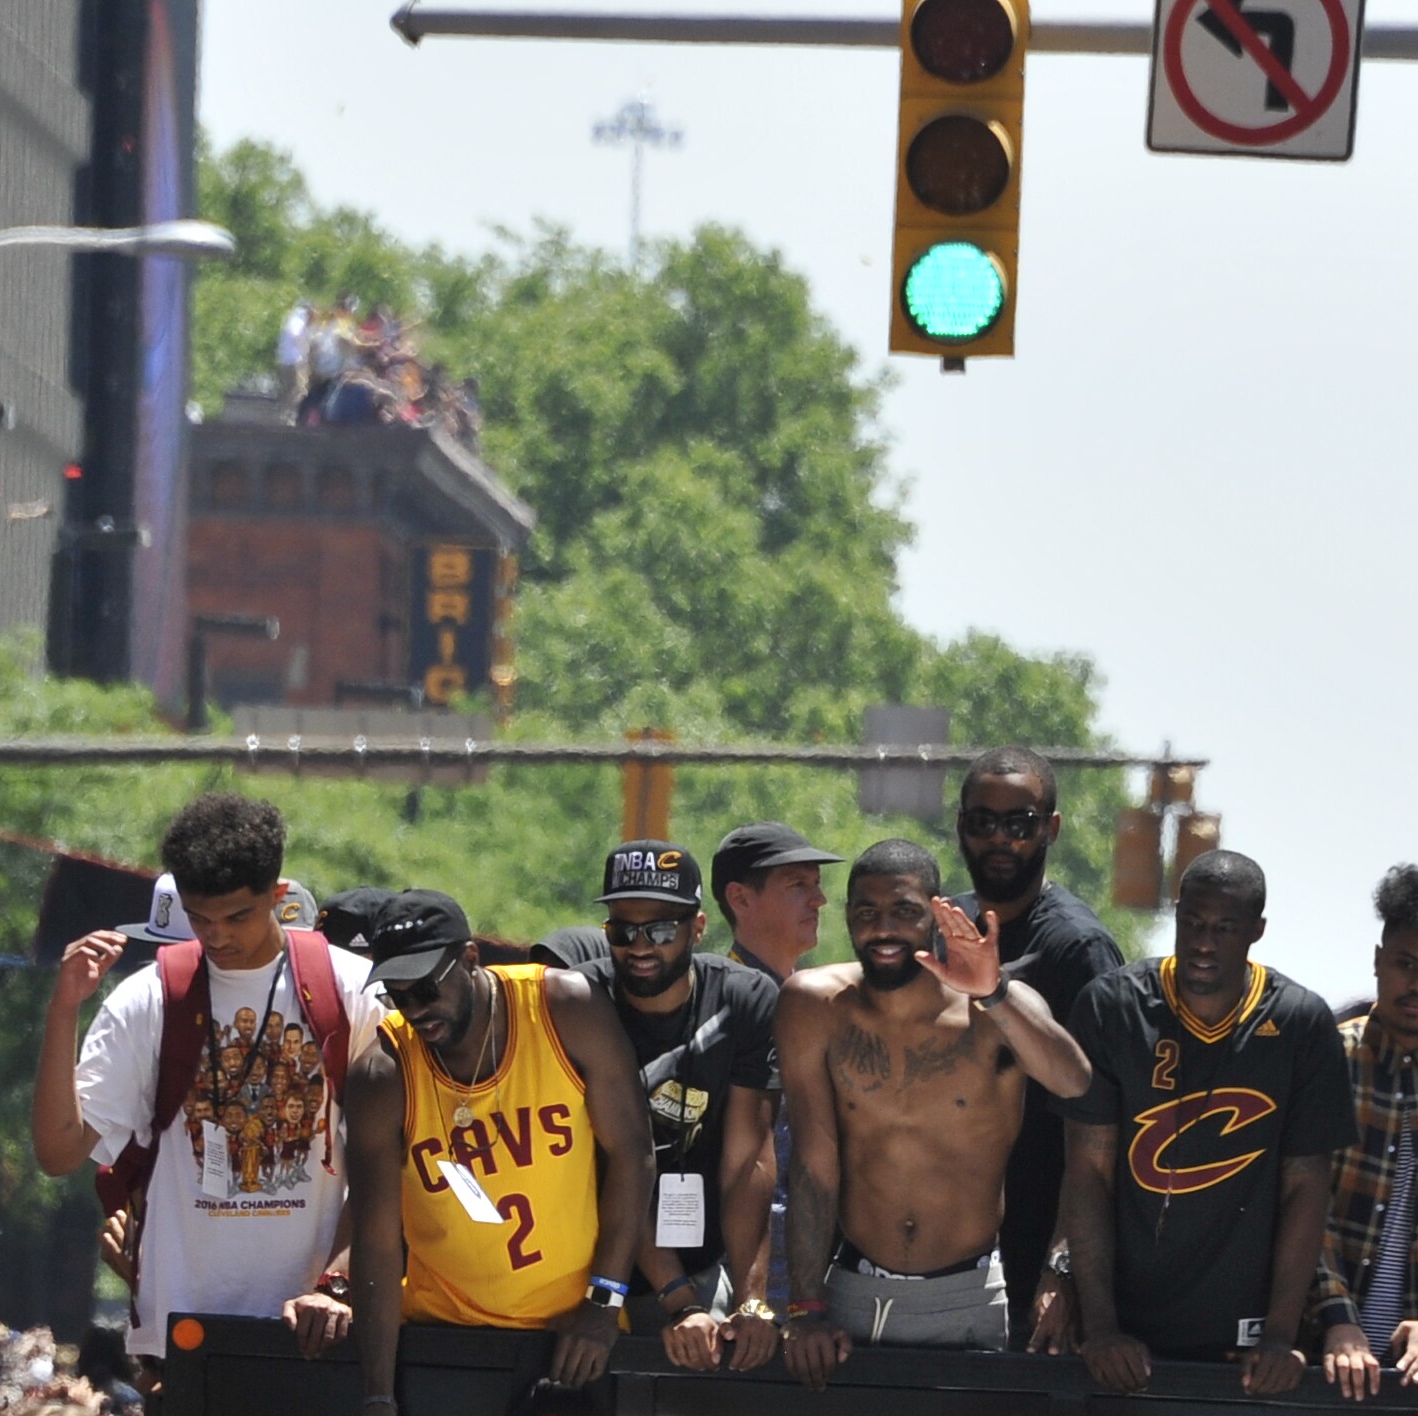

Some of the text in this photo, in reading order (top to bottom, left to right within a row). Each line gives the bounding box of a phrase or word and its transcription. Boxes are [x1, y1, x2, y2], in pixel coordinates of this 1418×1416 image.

[614, 851, 657, 872] NBA
[1150, 1039, 1180, 1091] 2
[410, 1102, 575, 1195] CAVS
[194, 1198, 307, 1211] 2016 NBA CHAMPIONS
[207, 1208, 251, 1217] CLEVELAND
[495, 1192, 544, 1272] 2
